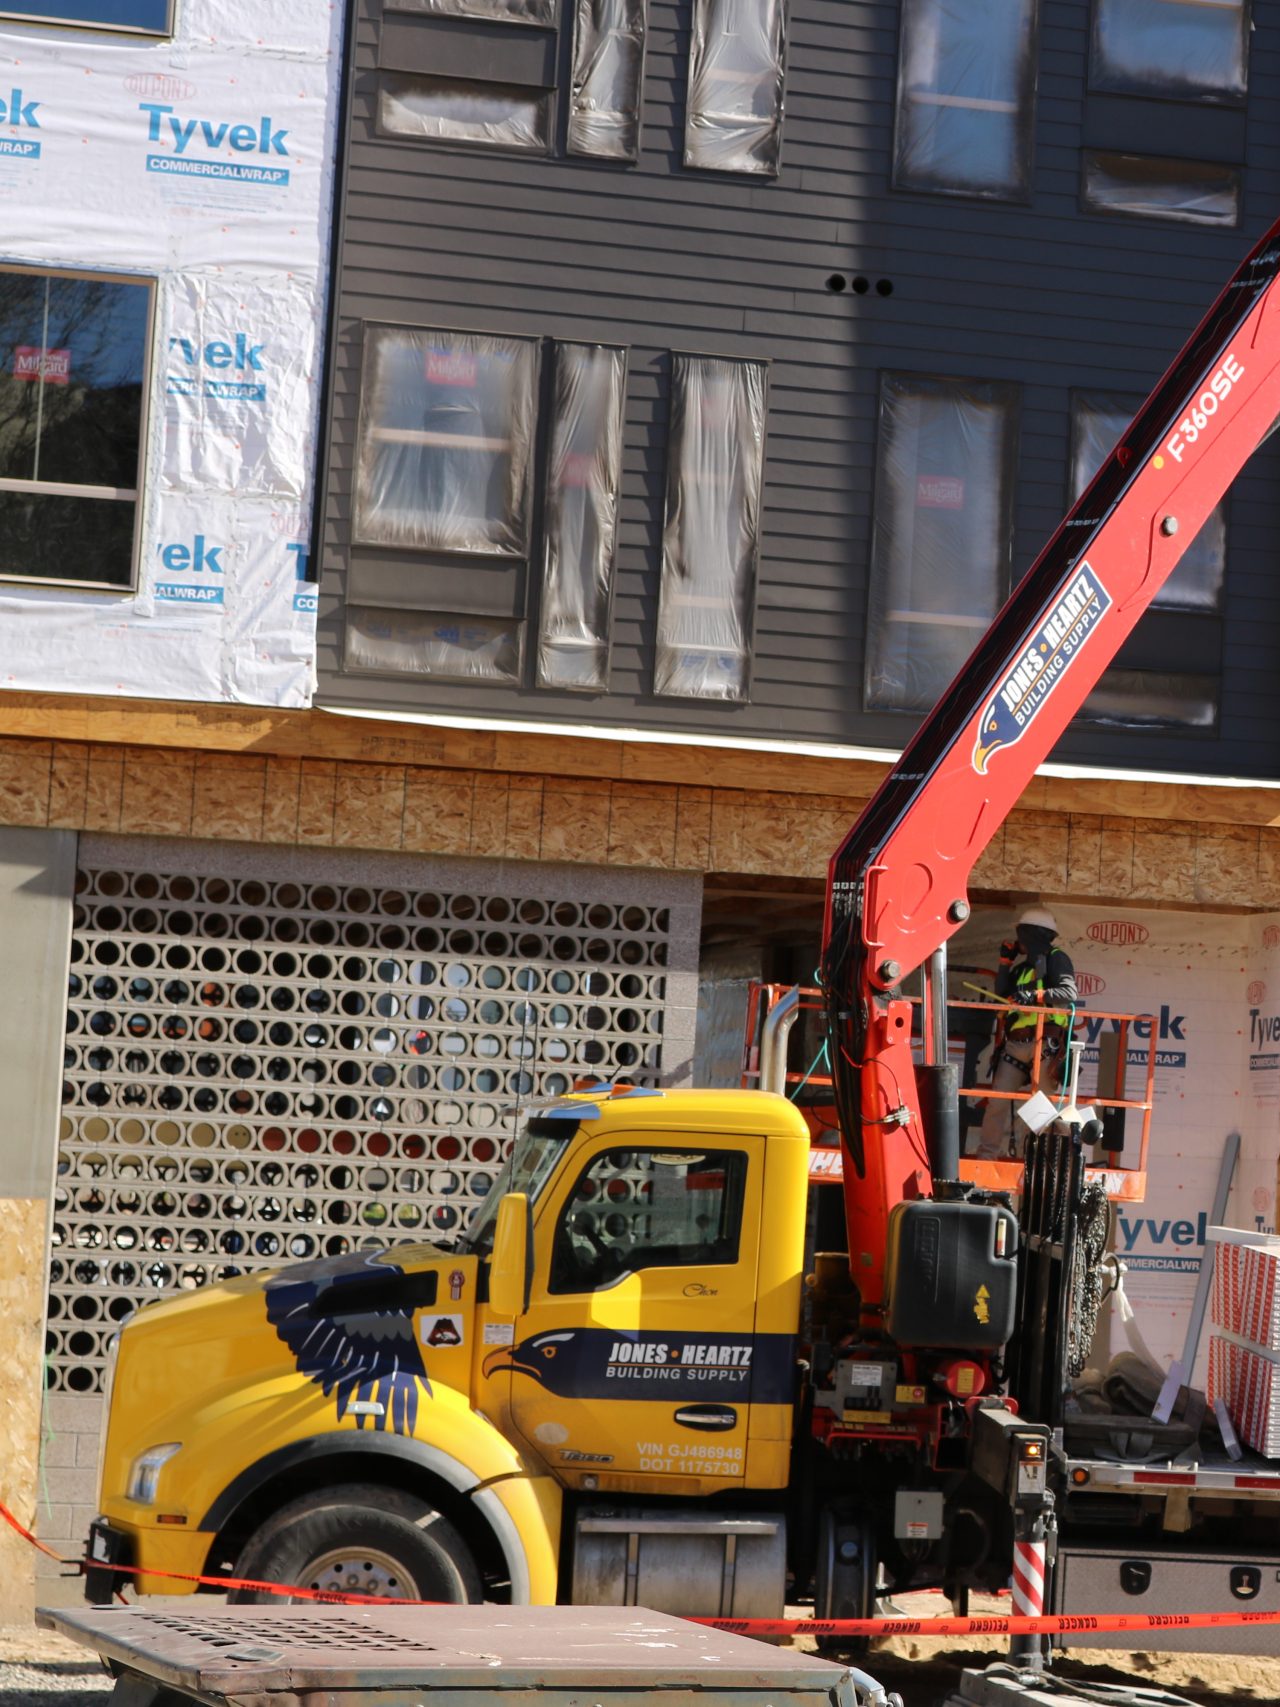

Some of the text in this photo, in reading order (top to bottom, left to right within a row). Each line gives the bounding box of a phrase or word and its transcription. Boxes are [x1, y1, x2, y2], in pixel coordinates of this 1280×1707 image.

[139, 103, 289, 156] Tyvek
[150, 158, 285, 182] COMMERCIALWRAP
[1166, 353, 1245, 463] F360SE
[1001, 575, 1094, 712] JONES HEARTZ
[1014, 597, 1101, 726] BUILDING SUPPLY
[609, 1343, 753, 1366] JONES HEARTZ
[606, 1366, 747, 1381] BUILDING SUPPLY
[637, 1442, 663, 1456] VIN
[640, 1458, 673, 1472] DOT
[968, 1620, 1009, 1632] PELIGRO
[1058, 1617, 1098, 1630] DANGER
